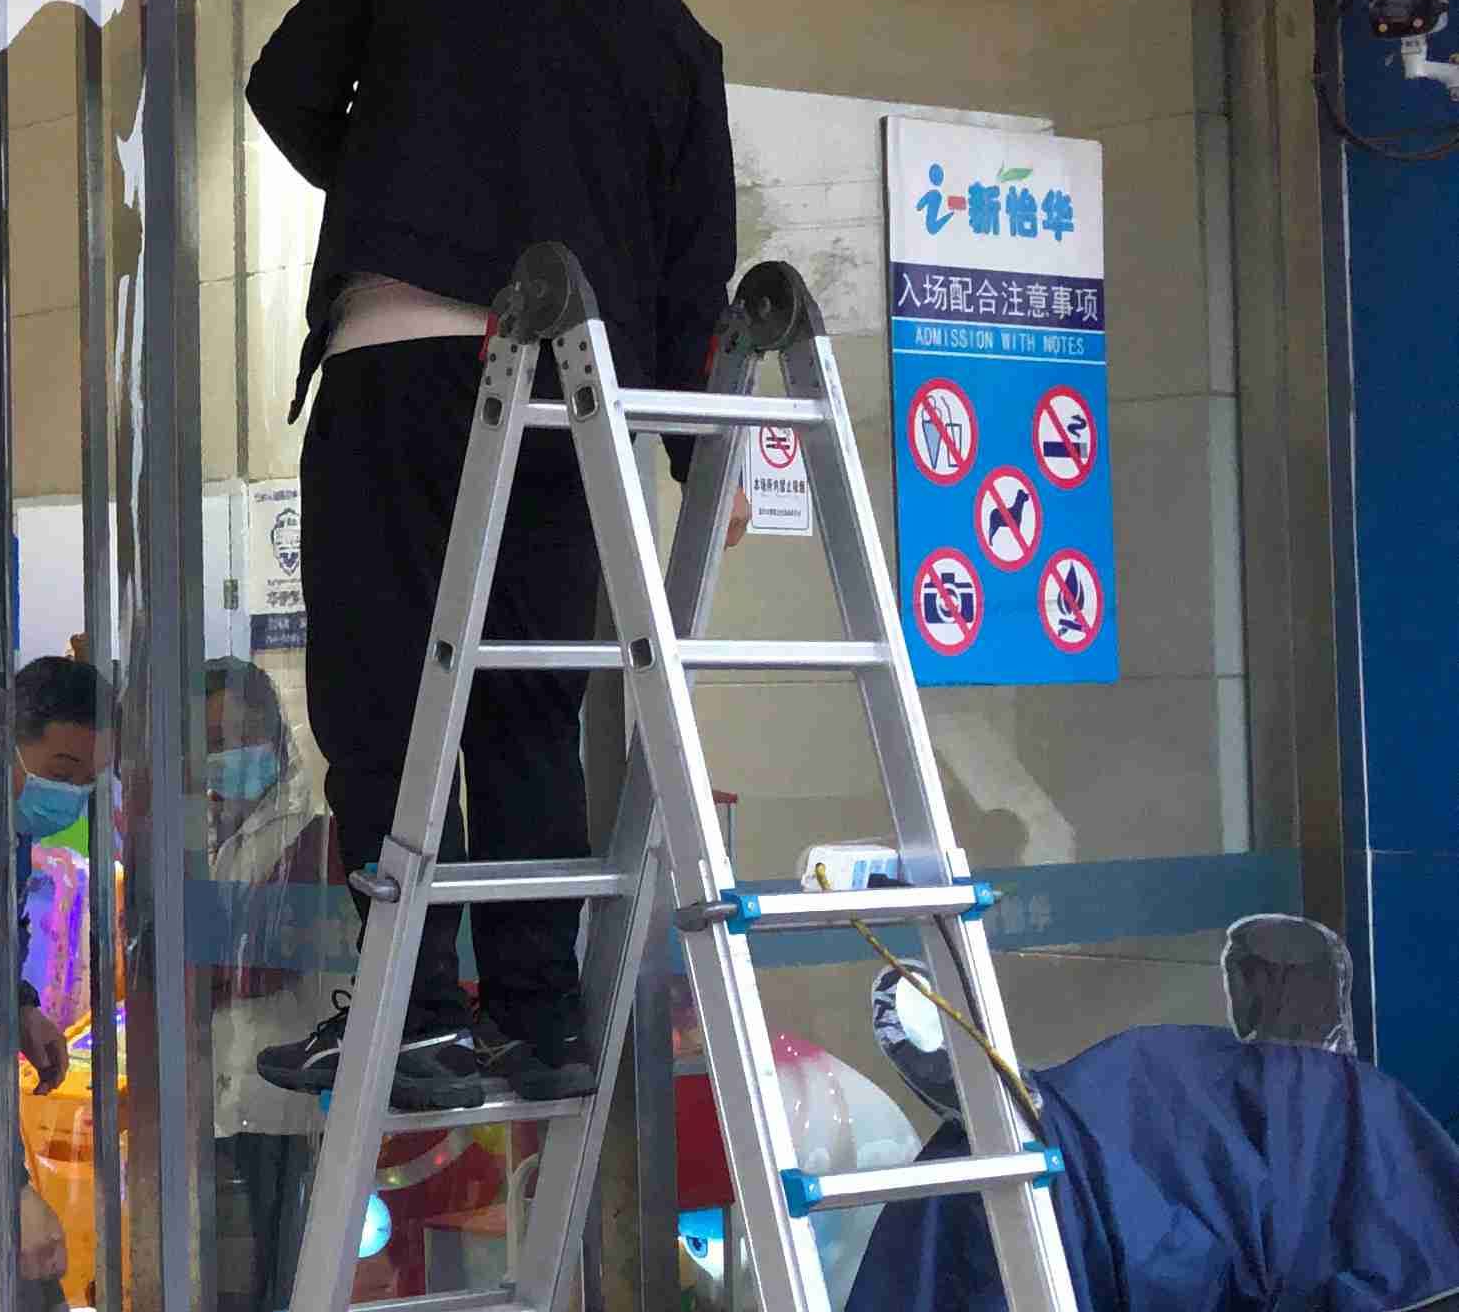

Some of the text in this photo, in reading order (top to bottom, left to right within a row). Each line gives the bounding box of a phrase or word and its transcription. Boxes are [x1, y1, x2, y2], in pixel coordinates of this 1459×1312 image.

[896, 272, 1099, 322] 入场配合注意事项
[914, 325, 1085, 356] ADMISSION WITH NOTES
